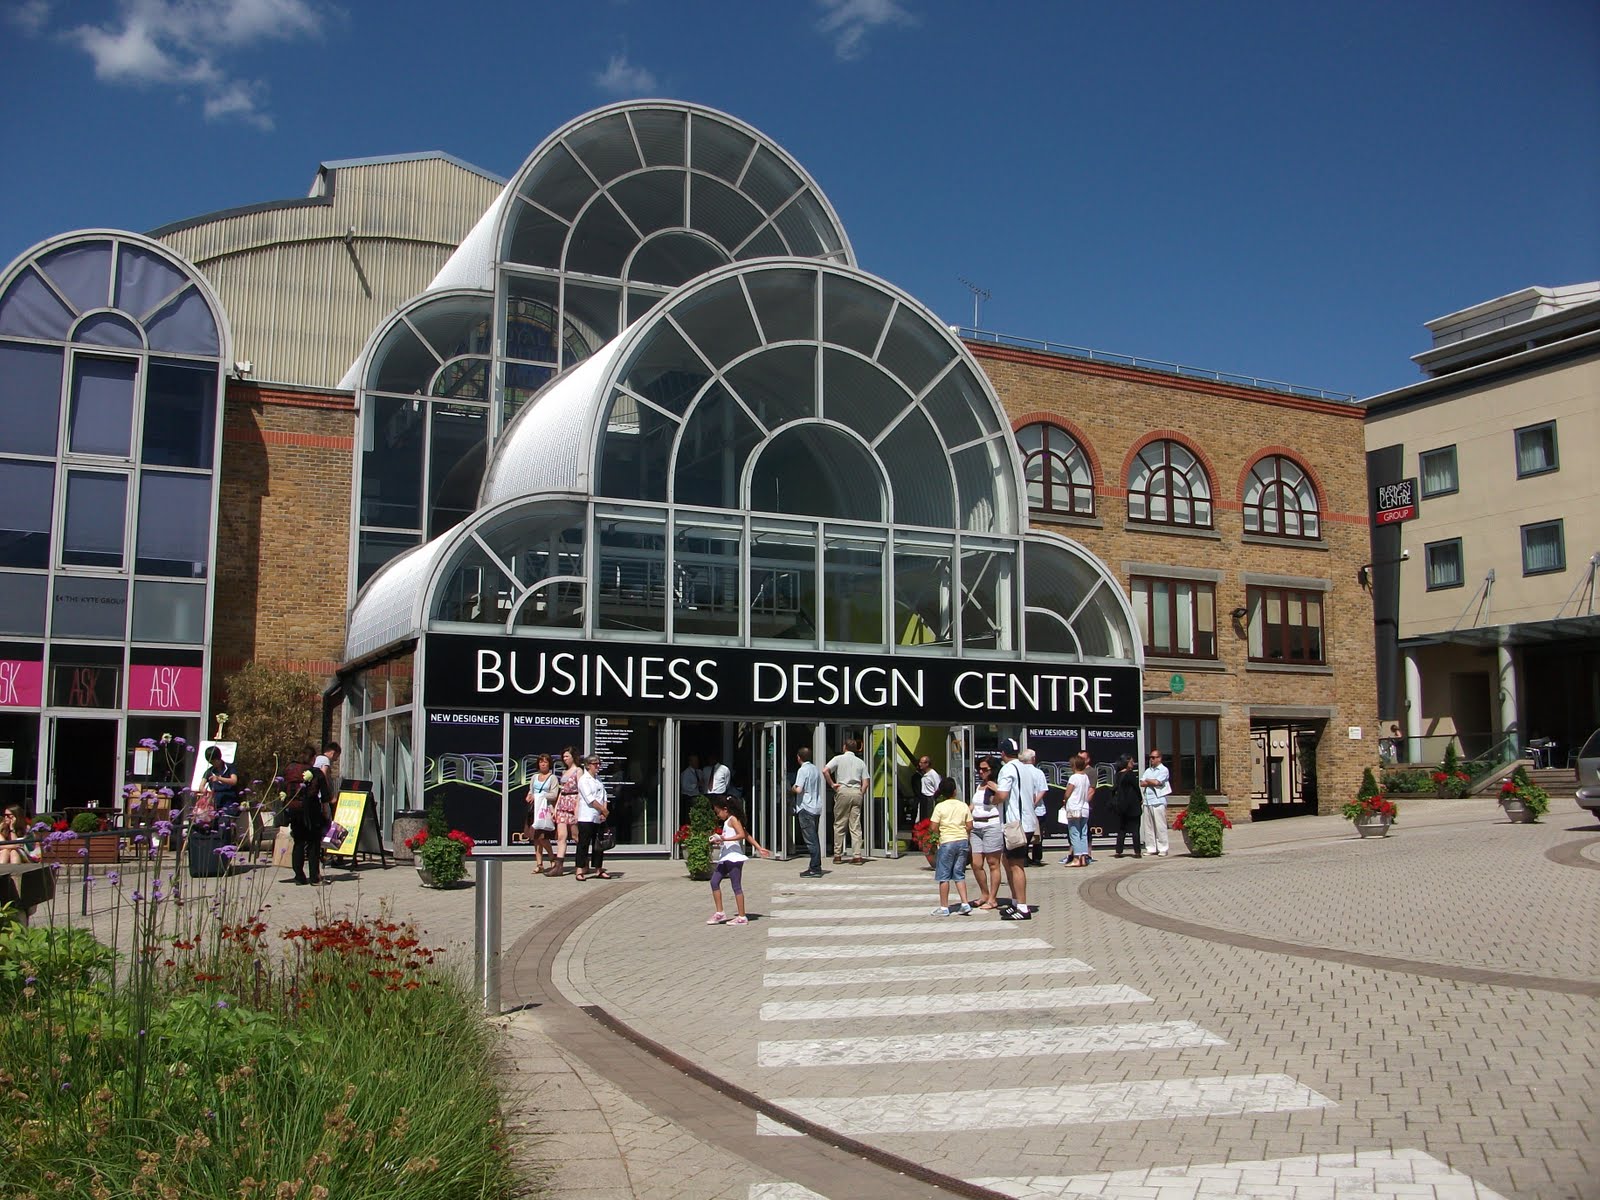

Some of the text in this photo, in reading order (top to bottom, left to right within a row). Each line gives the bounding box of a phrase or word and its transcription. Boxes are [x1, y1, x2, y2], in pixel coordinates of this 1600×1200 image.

[1380, 481, 1411, 494] BUSINESS
[1380, 488, 1411, 502] DESIGN
[1380, 494, 1412, 509] CENTRE
[1383, 509, 1409, 521] GROUP
[0, 662, 21, 704] SK
[69, 668, 100, 706] ASK
[150, 667, 181, 708] ASK
[477, 649, 1113, 713] BUSINESS DESIGN CENTRE
[430, 713, 500, 724] NEW DESIGNERS
[513, 716, 580, 726] NEW DESIGNERS
[1029, 728, 1078, 737] NEW DESIGNERS
